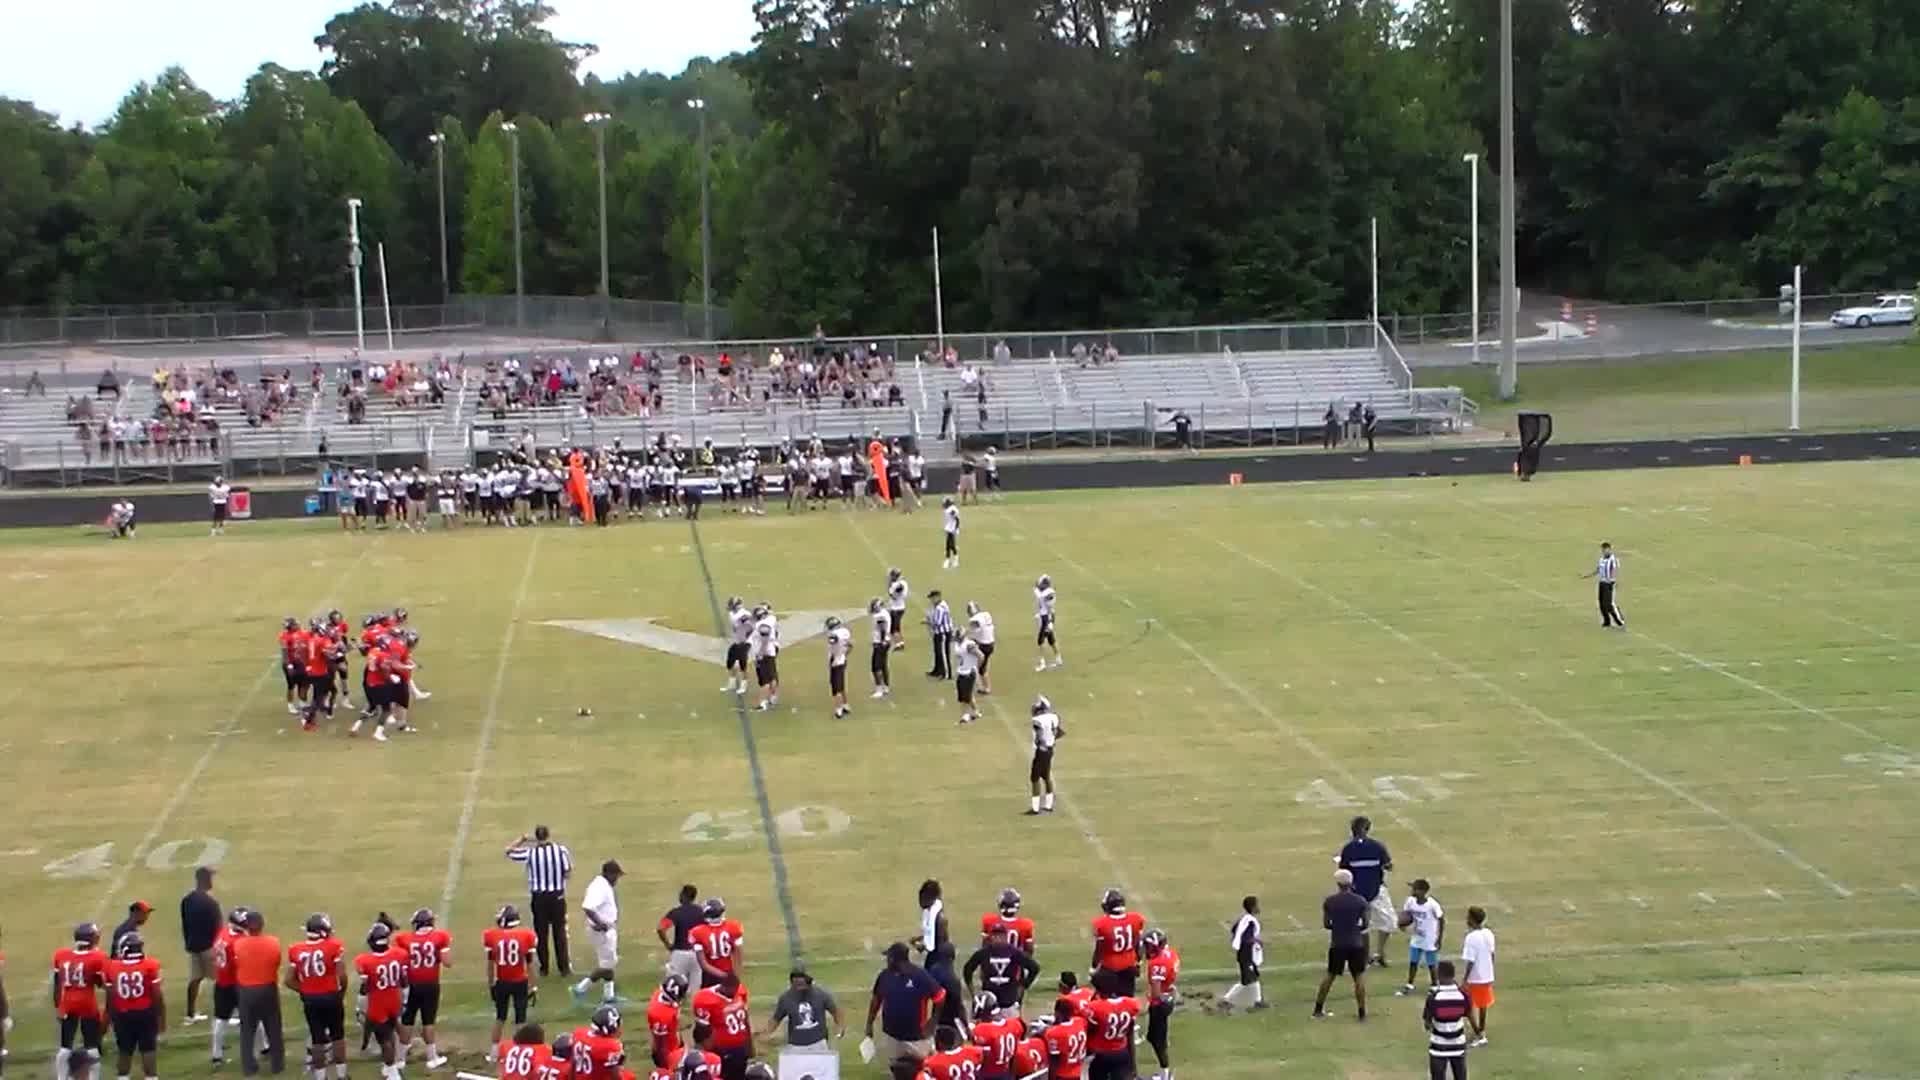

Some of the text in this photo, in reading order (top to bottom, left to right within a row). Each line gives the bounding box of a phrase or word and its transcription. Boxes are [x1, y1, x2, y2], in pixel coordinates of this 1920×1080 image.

[680, 805, 852, 841] 50
[42, 840, 230, 880] 40
[498, 939, 520, 966] 18
[709, 930, 731, 960] 16
[1113, 924, 1133, 952] 51
[299, 950, 326, 977] 76
[410, 941, 436, 968] 53
[63, 961, 86, 987] 14
[117, 971, 145, 999] 63
[376, 960, 400, 990] 30
[1104, 1010, 1131, 1041] 32
[505, 1047, 533, 1076] 66
[572, 1041, 593, 1074] 65
[998, 1033, 1016, 1065] 19
[1068, 1030, 1088, 1063] 22
